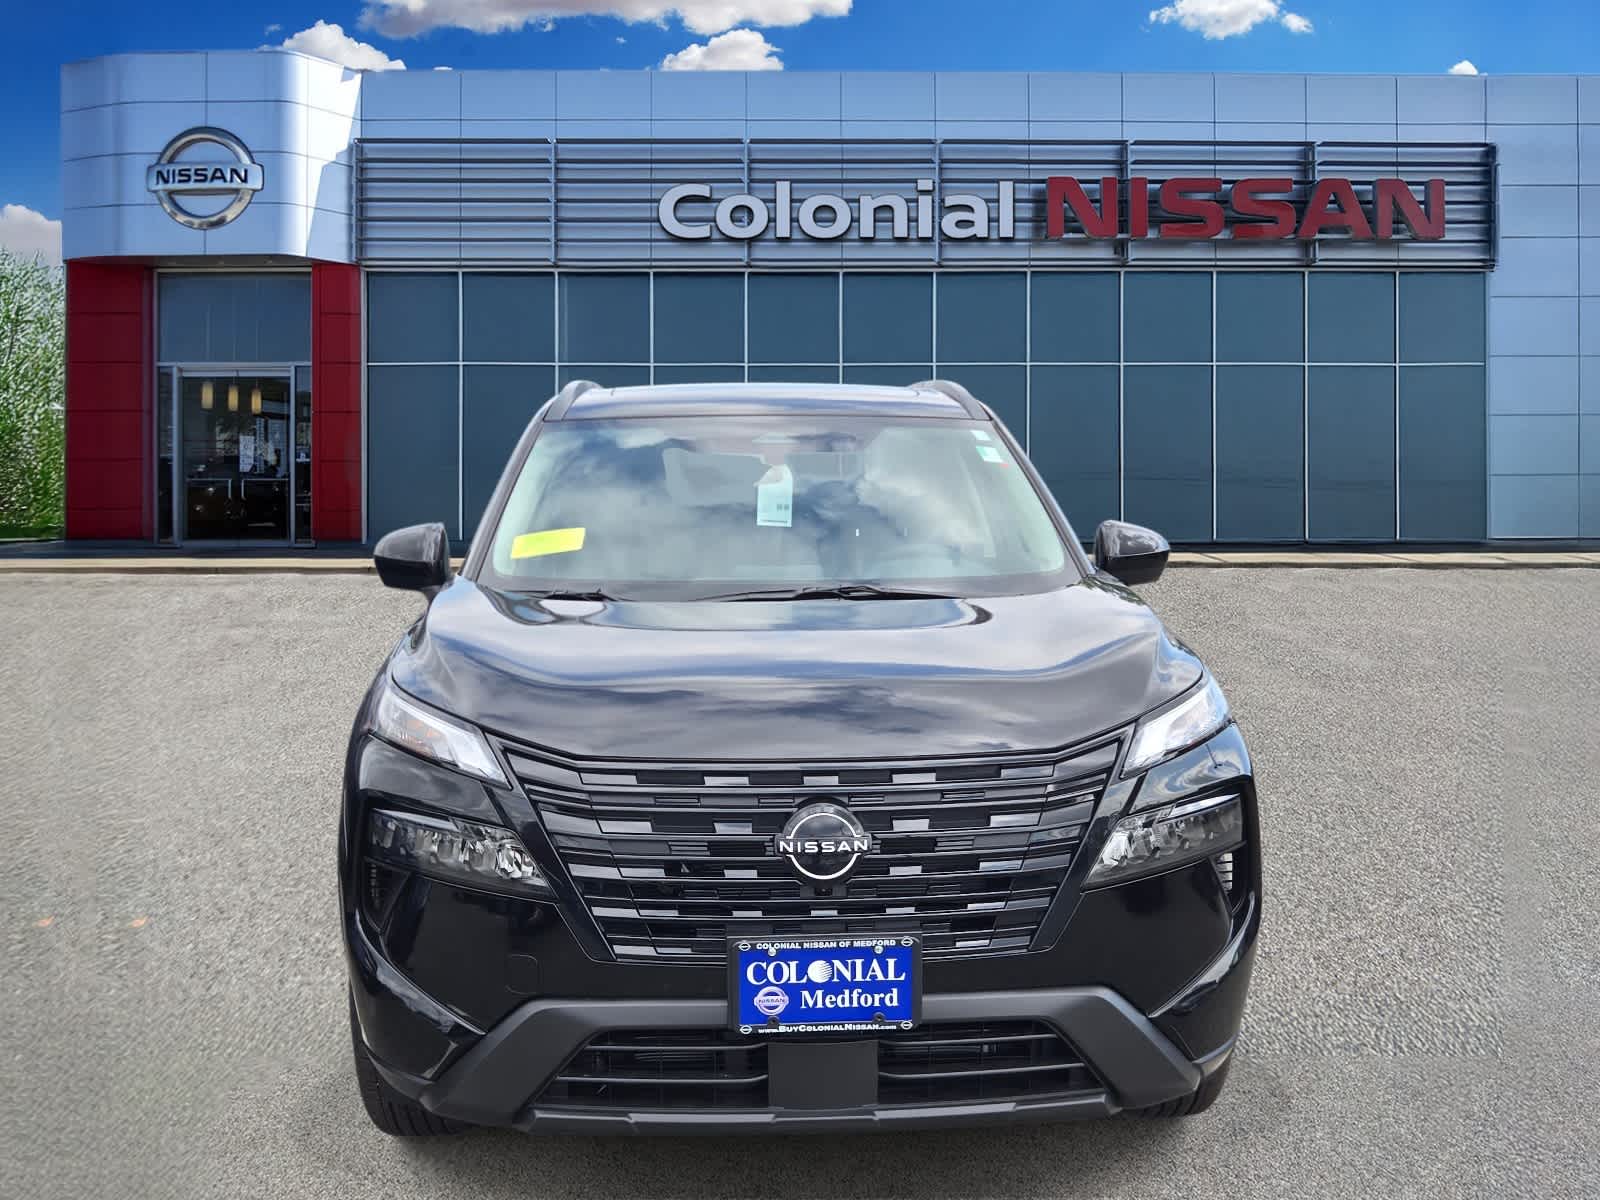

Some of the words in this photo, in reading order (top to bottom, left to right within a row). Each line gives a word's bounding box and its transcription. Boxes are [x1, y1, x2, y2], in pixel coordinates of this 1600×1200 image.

[156, 167, 248, 185] NISSAN
[658, 180, 1015, 240] Colonial
[1046, 176, 1446, 240] NISSAN
[779, 839, 868, 853] NISSAN
[756, 942, 800, 950] COLONIAL
[803, 941, 837, 949] NISSAN
[839, 940, 850, 948] OF
[853, 939, 896, 947] MEDFORD
[746, 958, 906, 985] COLONIAL
[800, 988, 899, 1009] Medford
